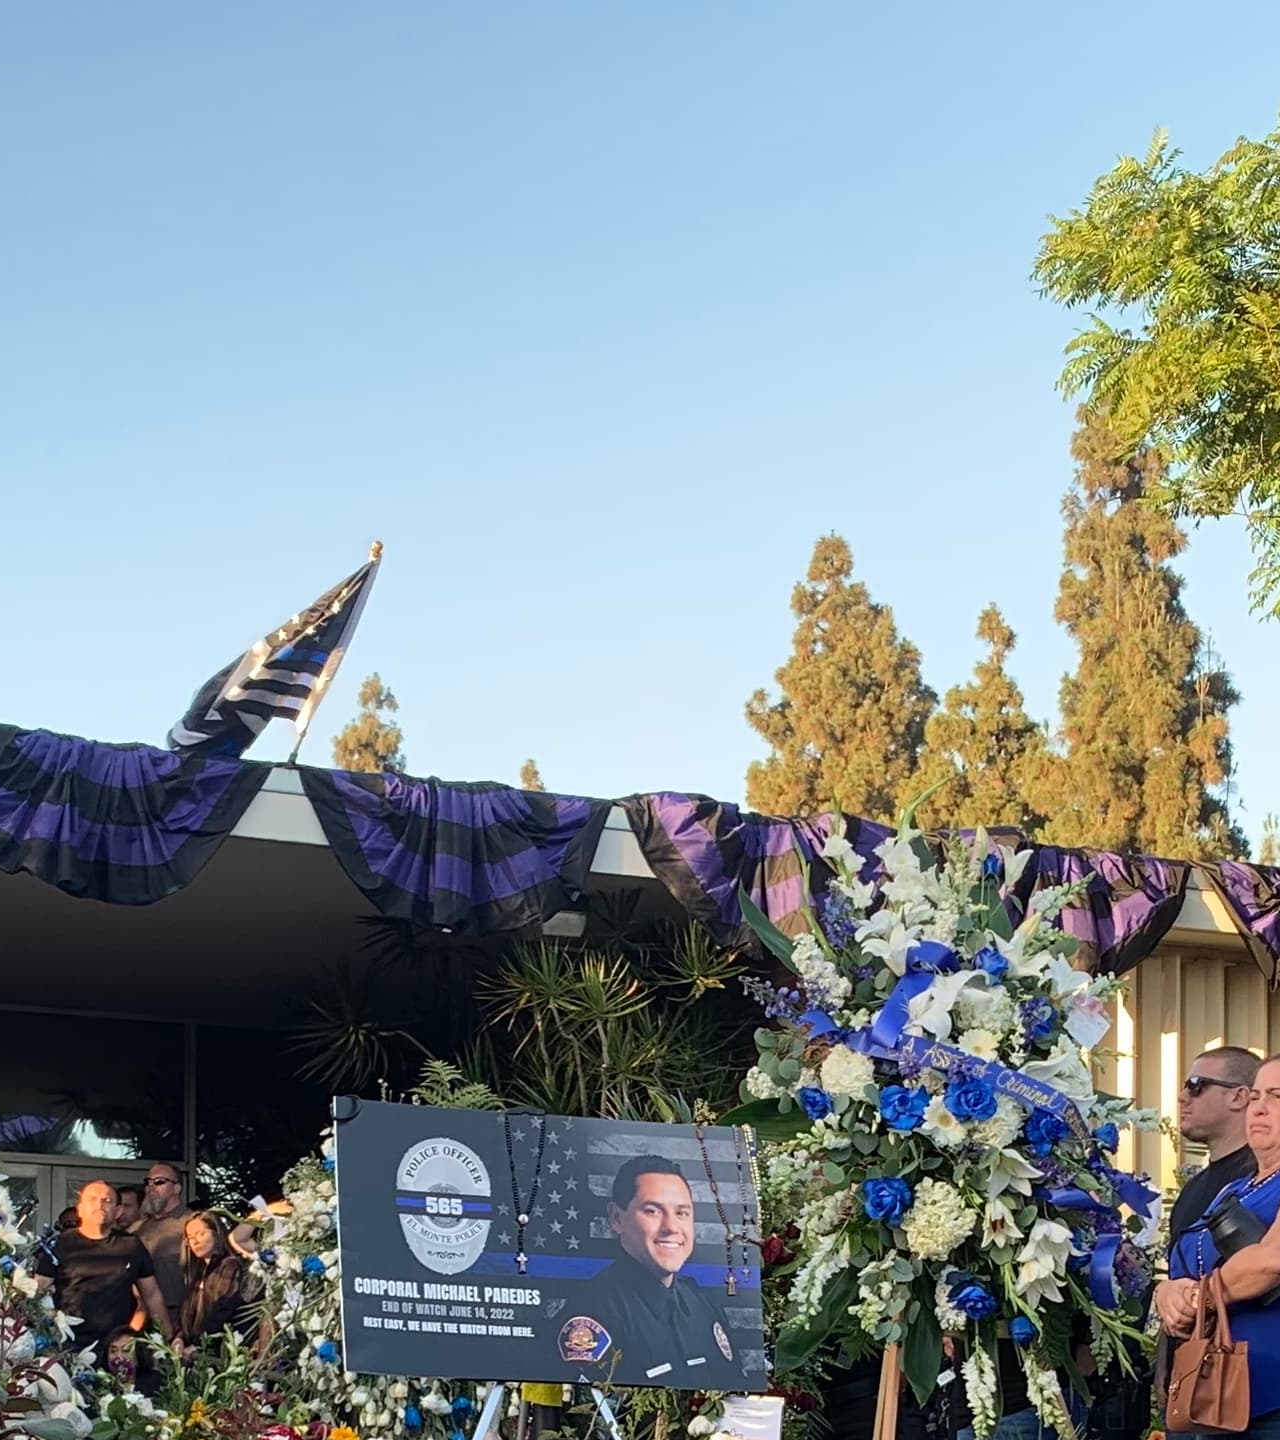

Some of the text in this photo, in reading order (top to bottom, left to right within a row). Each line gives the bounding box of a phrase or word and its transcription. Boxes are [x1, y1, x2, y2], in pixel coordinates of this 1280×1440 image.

[996, 1069, 1058, 1109] Criminal
[405, 1146, 483, 1184] POLICE OFFICER
[425, 1196, 463, 1216] 565
[406, 1218, 484, 1243] EL MONTE POLICE
[354, 1277, 541, 1306] CORPORAL MICHAEL PAREDES
[382, 1300, 400, 1313] END
[401, 1302, 414, 1314] OF
[415, 1303, 448, 1316] WATCH
[449, 1305, 473, 1318] JUNE
[490, 1308, 515, 1320] 2022
[363, 1317, 382, 1328] REST
[408, 1320, 421, 1332] WE
[422, 1321, 442, 1333] HAVE
[443, 1322, 458, 1334] THE
[459, 1323, 487, 1335] WATCH
[488, 1325, 511, 1337] FROM
[512, 1326, 535, 1338] HERE.
